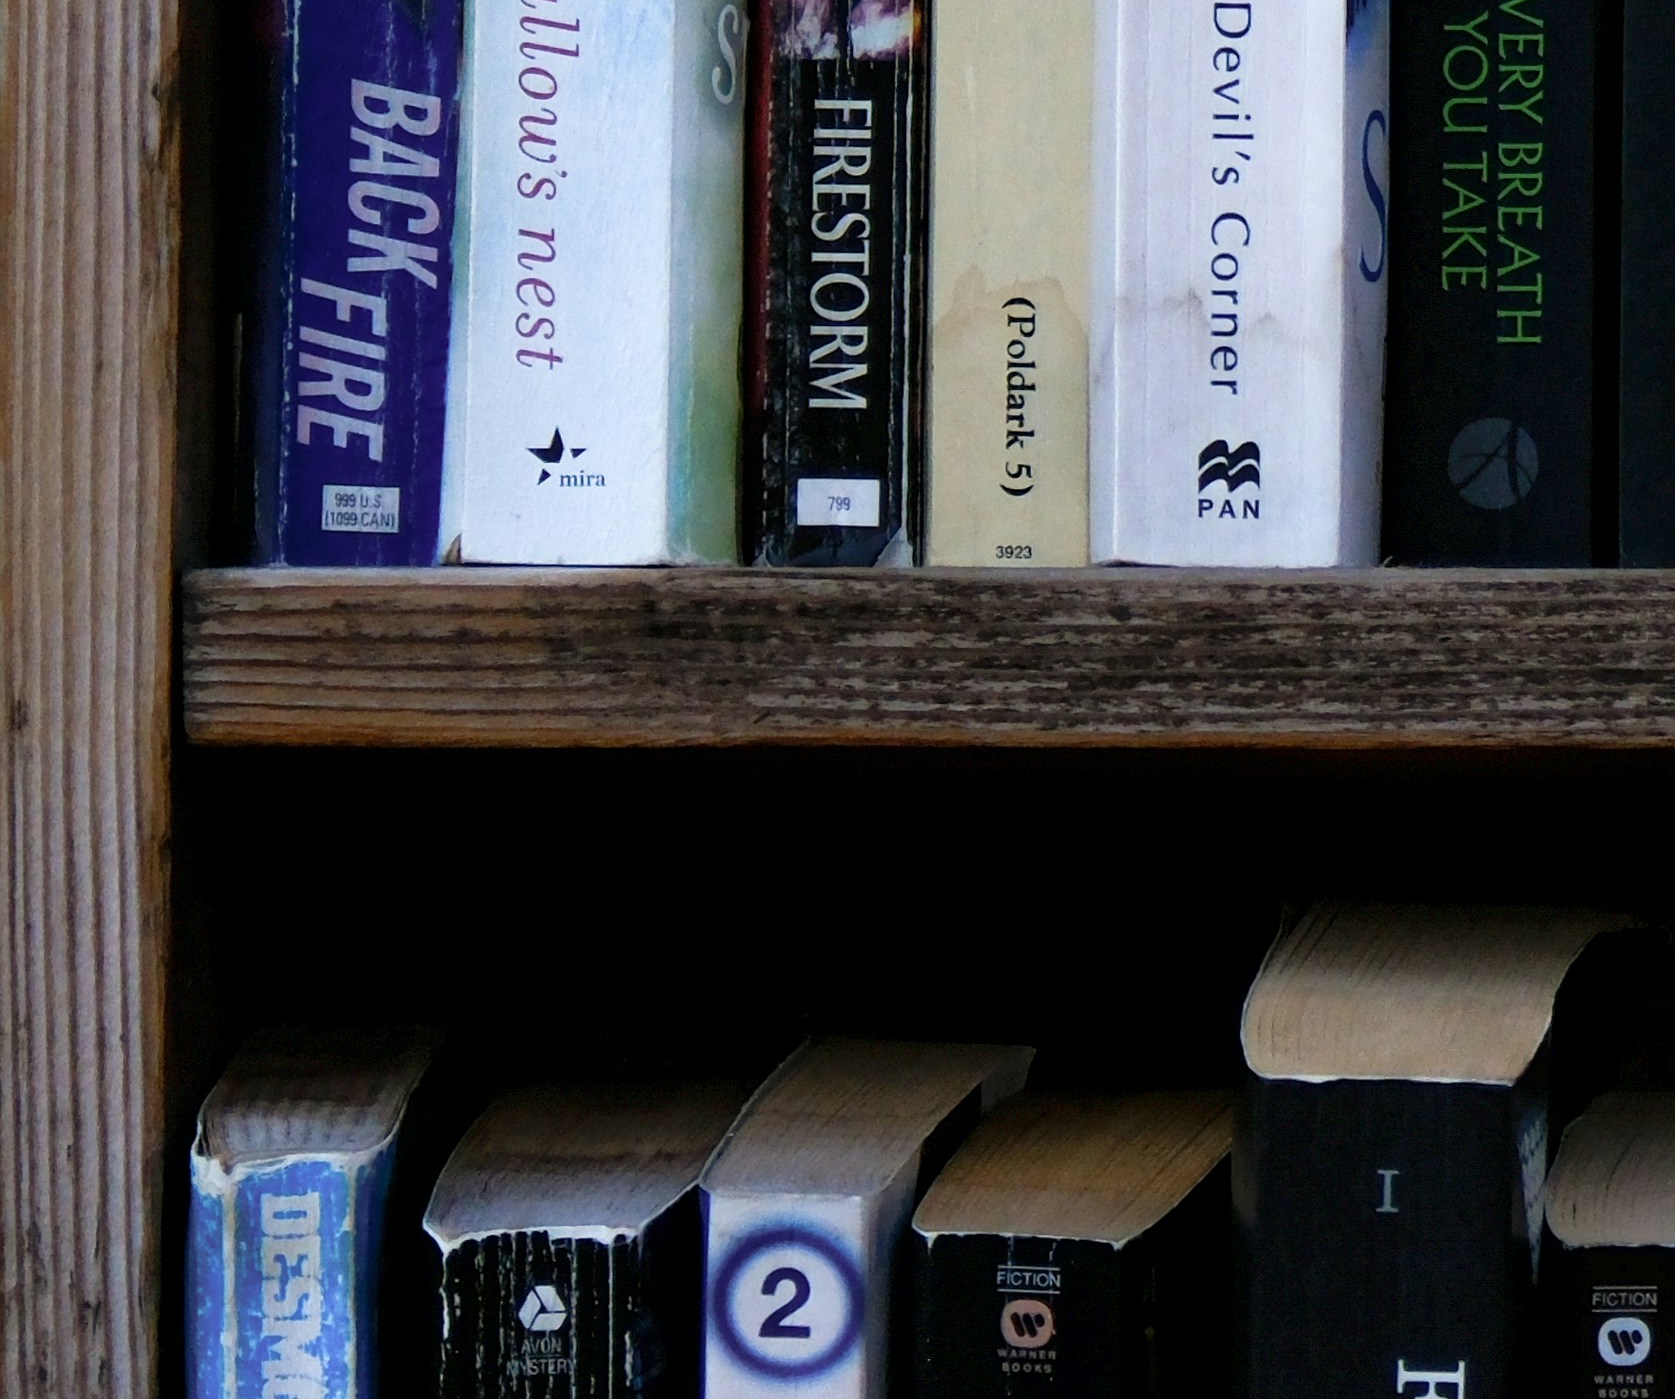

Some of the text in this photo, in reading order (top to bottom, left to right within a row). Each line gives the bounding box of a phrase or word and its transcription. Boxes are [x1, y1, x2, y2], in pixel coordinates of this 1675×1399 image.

[346, 77, 443, 289] BACK
[1208, 1, 1254, 396] Devil's Corner
[1440, 10, 1490, 292] YOU TAKE
[806, 97, 873, 412] FIRESTORM
[297, 277, 389, 464] FIRE
[1000, 295, 1038, 497] (Poldark 5)
[558, 469, 607, 489] mira
[1198, 499, 1262, 520] PAN
[520, 1337, 563, 1354] AVON
[757, 1266, 812, 1339] 2
[996, 1348, 1058, 1360] WARNER
[1593, 1373, 1656, 1384] WARNER
